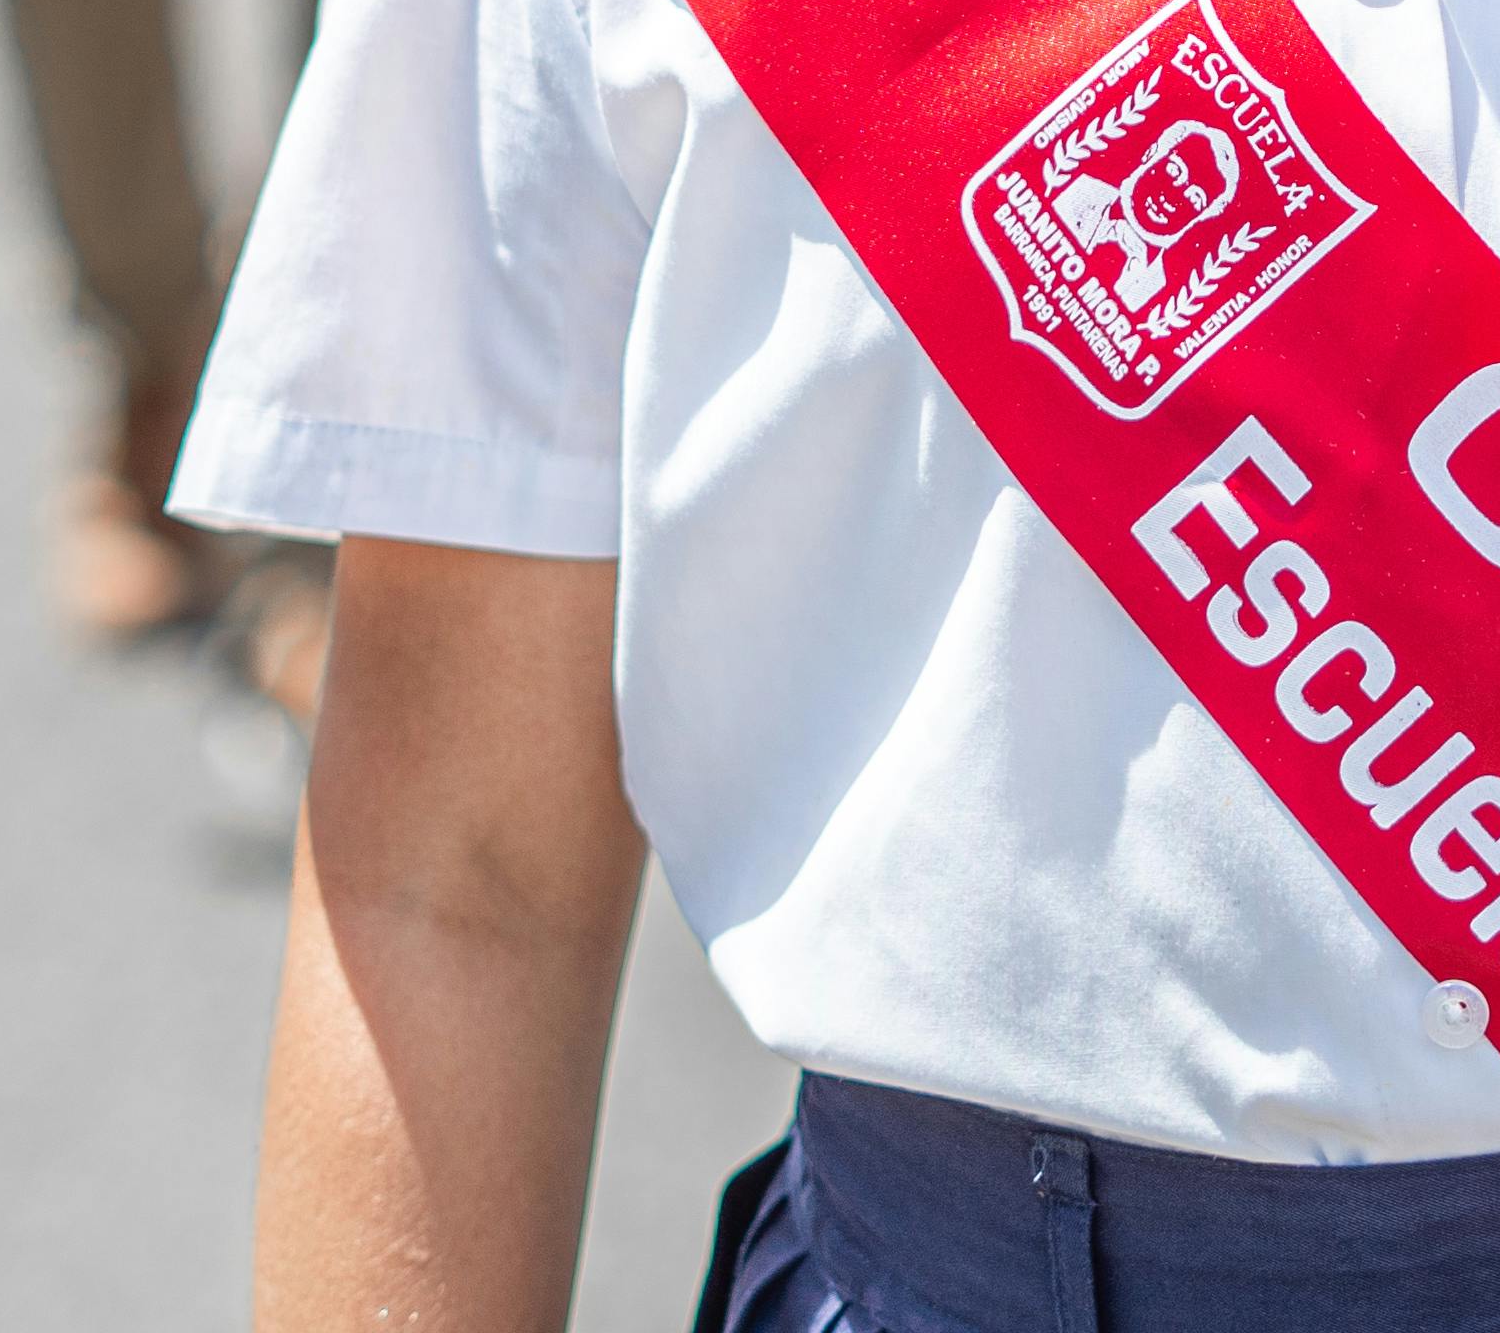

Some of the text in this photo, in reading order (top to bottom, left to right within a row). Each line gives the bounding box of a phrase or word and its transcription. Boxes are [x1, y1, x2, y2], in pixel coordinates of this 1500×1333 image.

[1033, 38, 1150, 150] AMOR CIVISMO
[1170, 33, 1314, 218] ESCUELA
[992, 203, 1130, 382] BARRANCA, PUNTARENAS
[996, 171, 1162, 386] JUANITO MORA P.
[1021, 284, 1063, 334] 1991
[1172, 234, 1314, 360] VALENTIA HONOR
